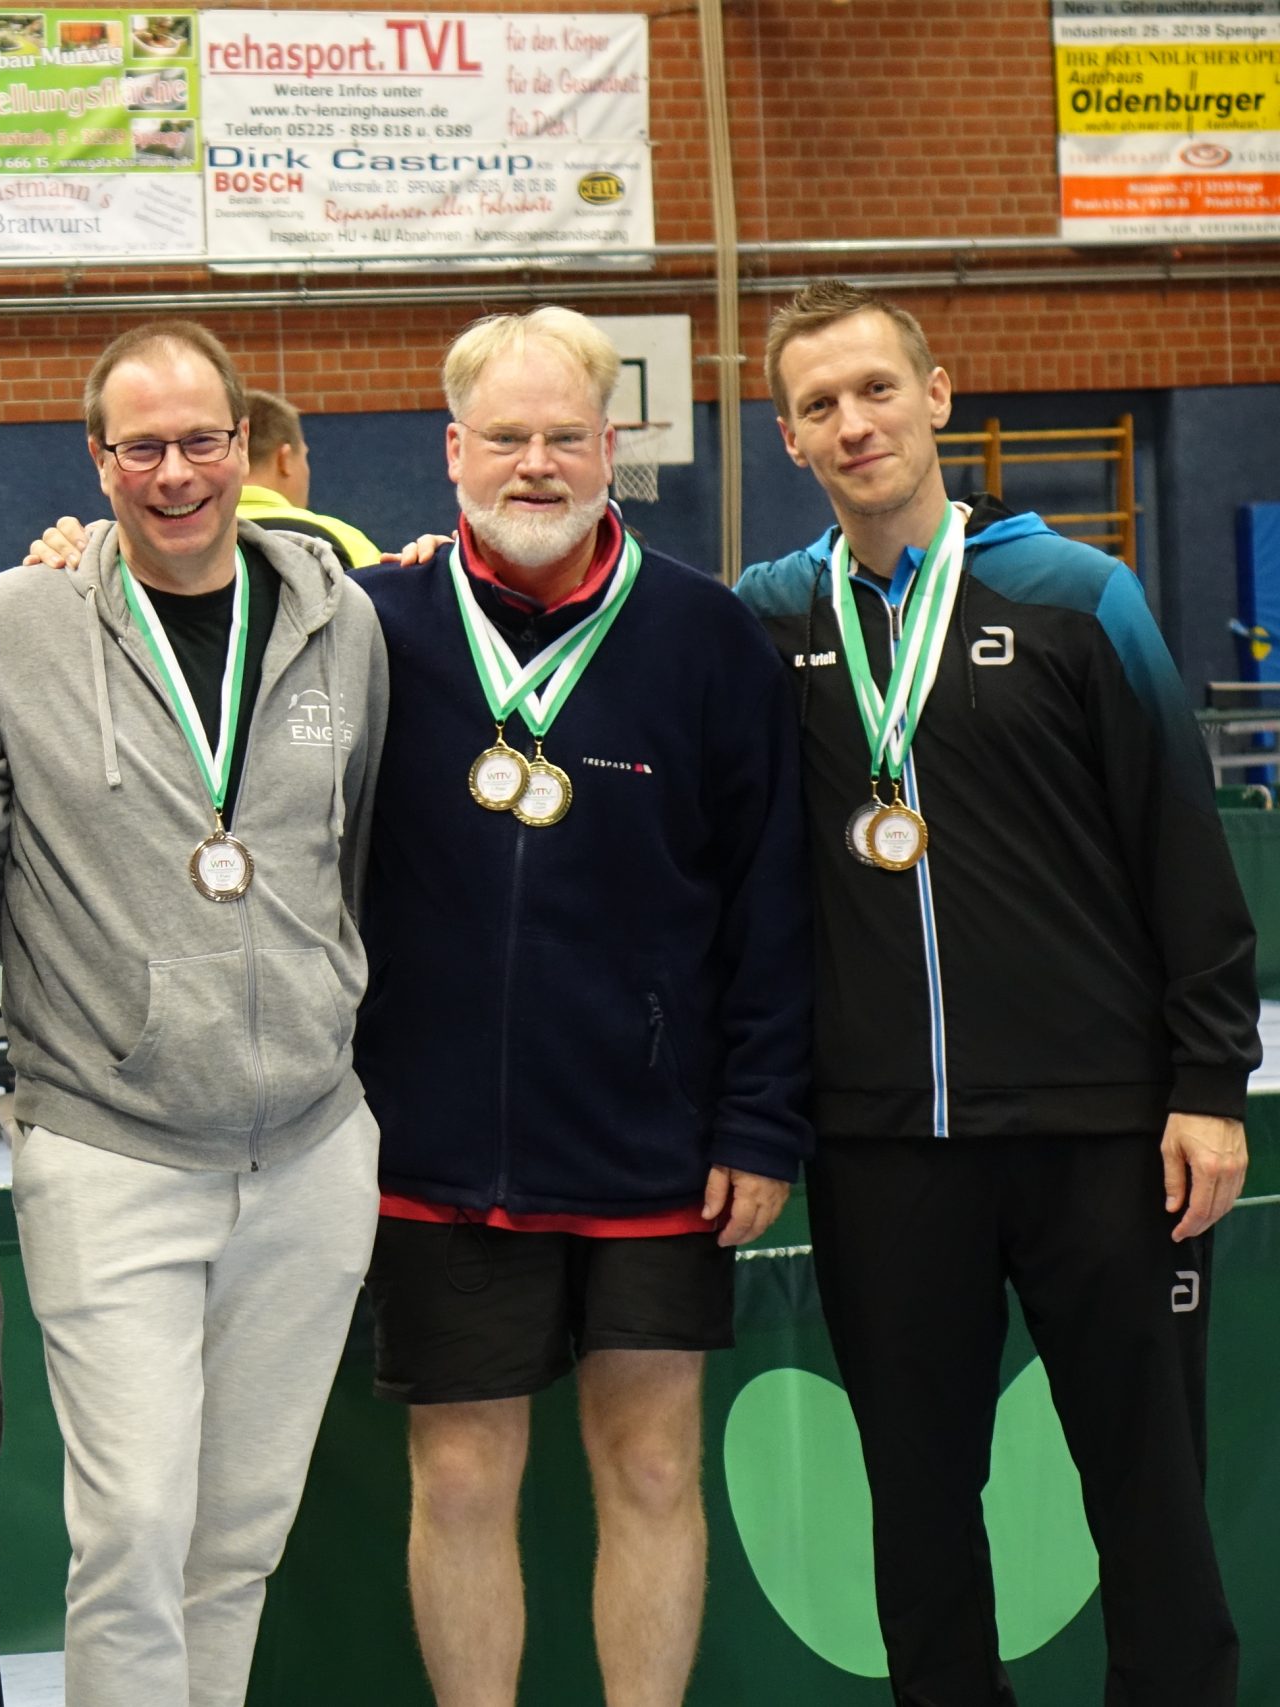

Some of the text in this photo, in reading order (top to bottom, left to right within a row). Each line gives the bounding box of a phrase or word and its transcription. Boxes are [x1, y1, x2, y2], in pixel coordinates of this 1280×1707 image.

[1215, 23, 1268, 40] Spenge
[274, 83, 423, 98] Weitere Infos unter
[250, 103, 449, 120] www.tv-lenzinghausen.de
[1070, 87, 1266, 119] Oldenburger
[225, 123, 282, 137] Telefon
[287, 123, 335, 137] 05225
[351, 123, 379, 138] 859
[383, 123, 412, 138] 818
[435, 124, 473, 138] 6389
[208, 146, 312, 169] Dirk
[332, 148, 534, 176] Castrup
[214, 171, 304, 193] BOSCH
[270, 229, 334, 246] Inspektion
[300, 704, 346, 725] TT
[291, 724, 353, 745] ENGR
[582, 756, 632, 771] TRESPASS
